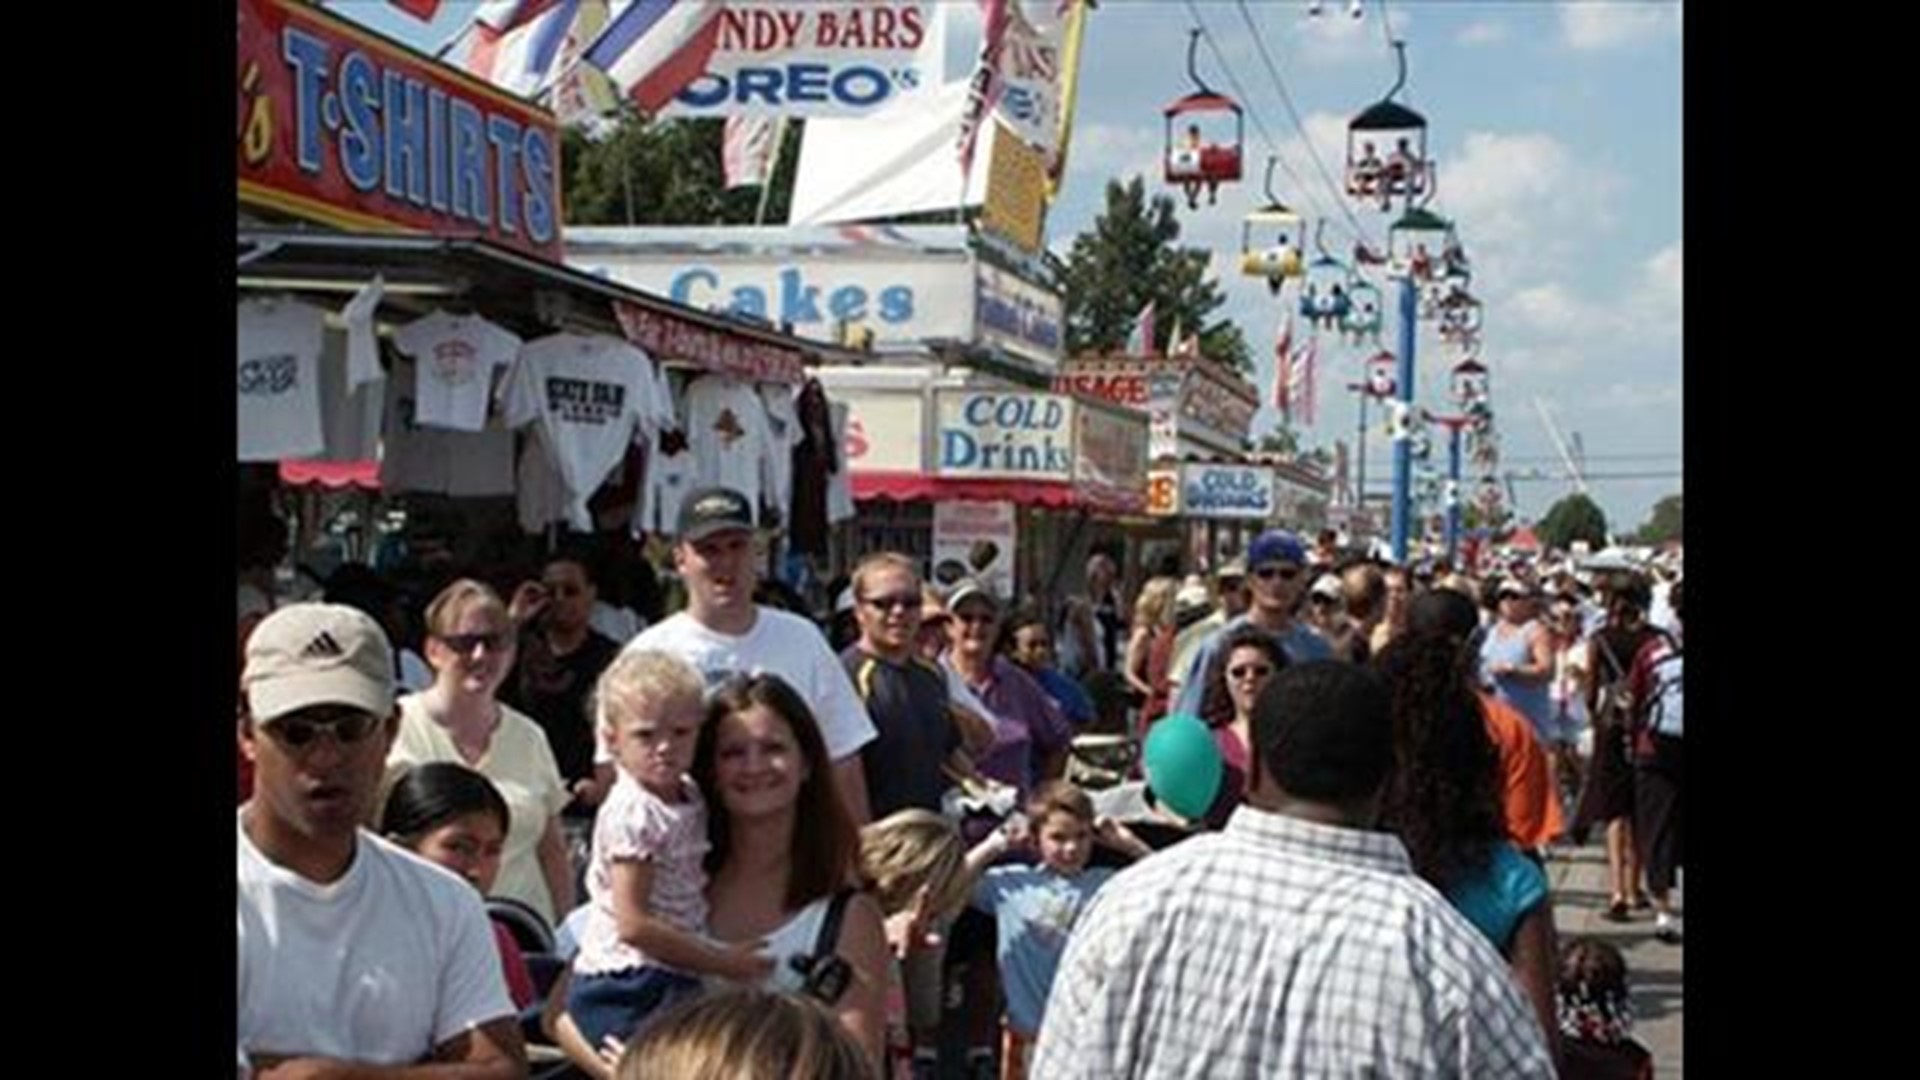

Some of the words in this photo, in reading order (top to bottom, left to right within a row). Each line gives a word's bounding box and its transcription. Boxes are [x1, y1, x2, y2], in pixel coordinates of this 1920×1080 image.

[718, 8, 804, 51] NDY
[815, 7, 923, 49] BARS
[670, 268, 914, 324] Cakes
[1054, 373, 1149, 404] USAGE
[965, 394, 1064, 430] COLD
